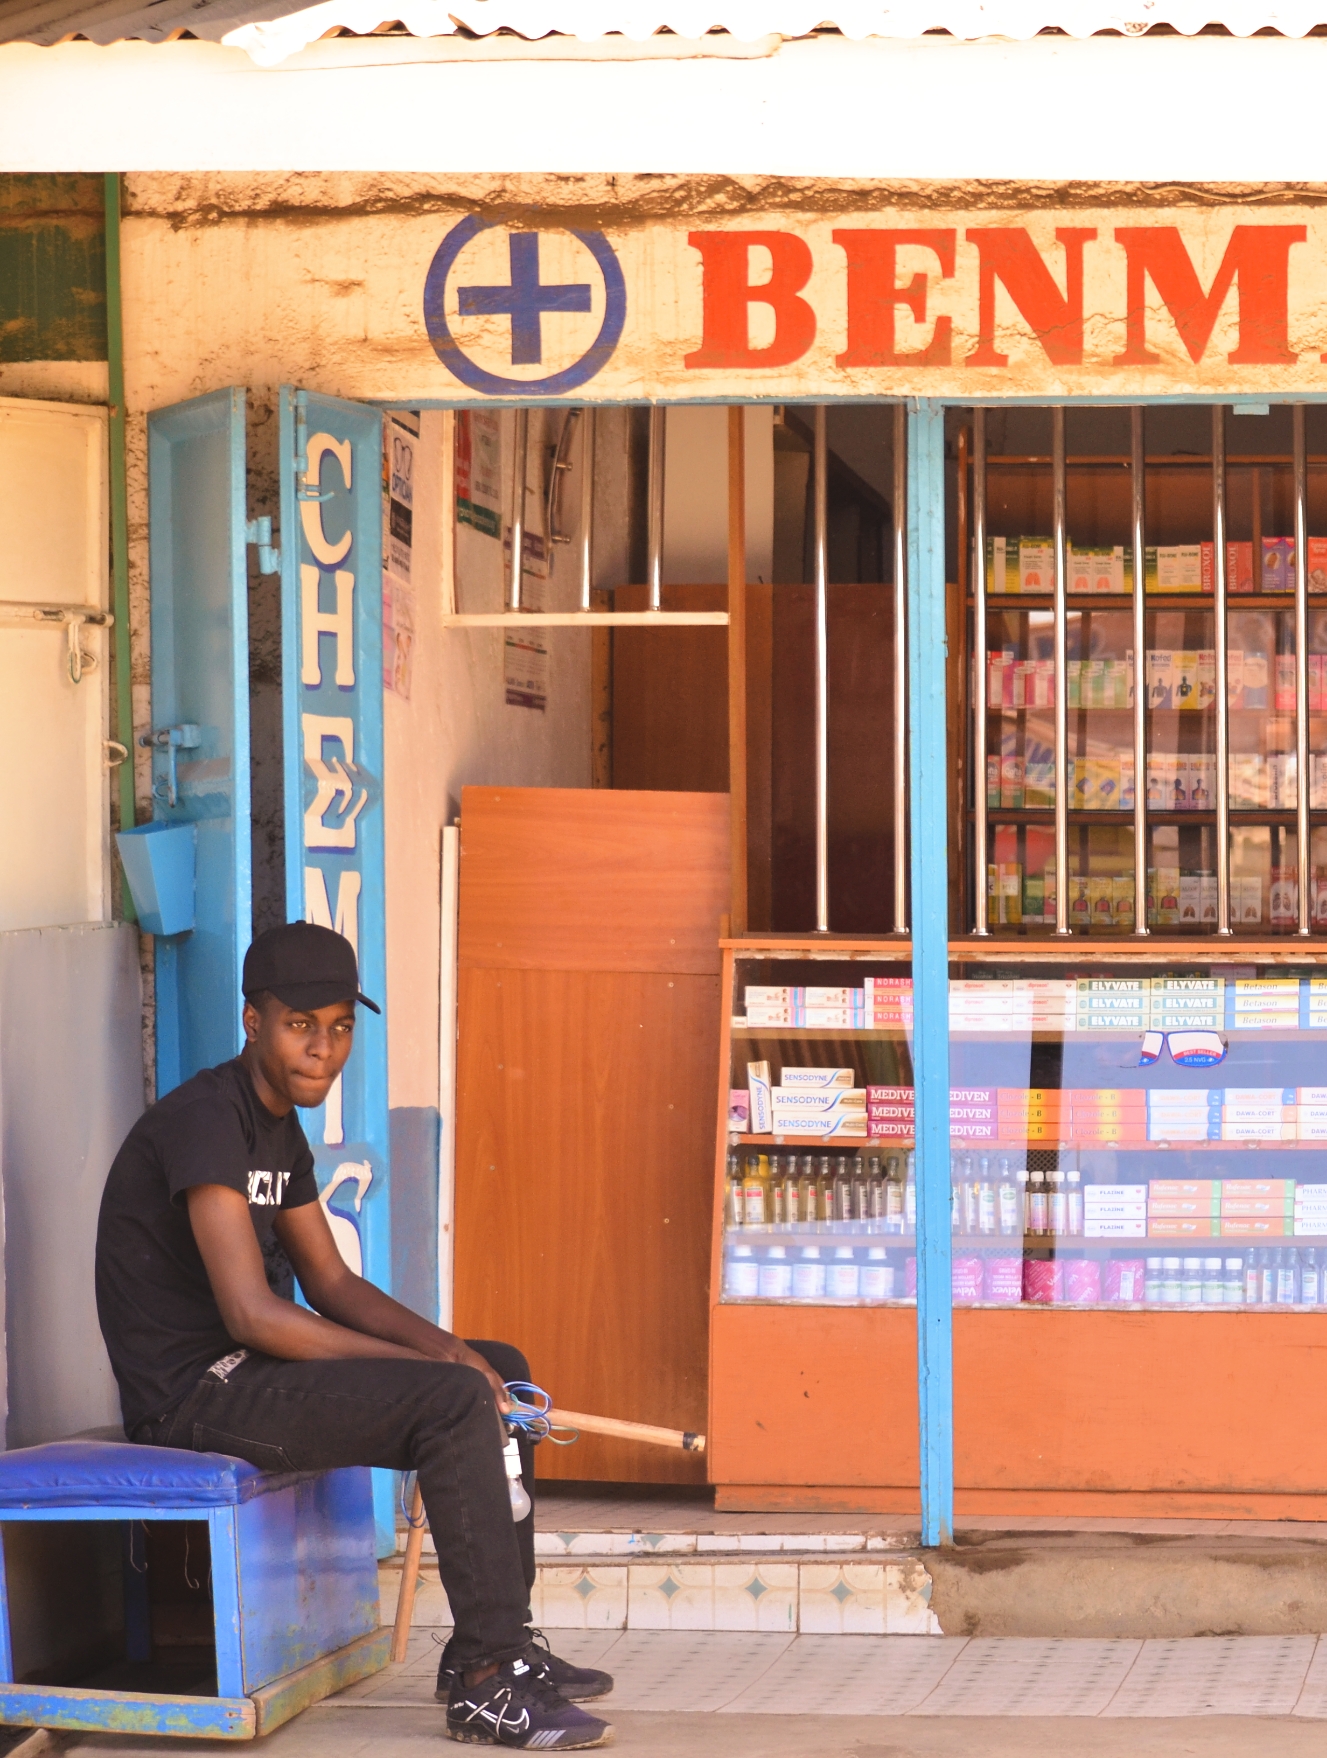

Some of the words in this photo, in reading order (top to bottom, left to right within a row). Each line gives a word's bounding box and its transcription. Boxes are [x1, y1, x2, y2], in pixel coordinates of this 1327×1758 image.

[1092, 981, 1139, 990] ELYVATE
[1167, 980, 1215, 989] ELYVATE
[1092, 998, 1139, 1008] ELYVATE
[1166, 998, 1214, 1008] ELYVATE
[1091, 1016, 1139, 1026] ELYVATE
[1166, 1016, 1213, 1025] ELYVATE
[784, 1074, 827, 1082] SENSODYNE
[871, 1089, 914, 1100] MEDIVE
[950, 1092, 989, 1101] EDIVEN
[776, 1095, 830, 1104] SENSODYNE
[872, 1107, 914, 1116] MEDIVE
[950, 1109, 991, 1118] EDIVEN
[777, 1119, 832, 1128] SENSODYNE
[872, 1123, 914, 1134] MEDIVE
[950, 1126, 991, 1136] EDIVEN
